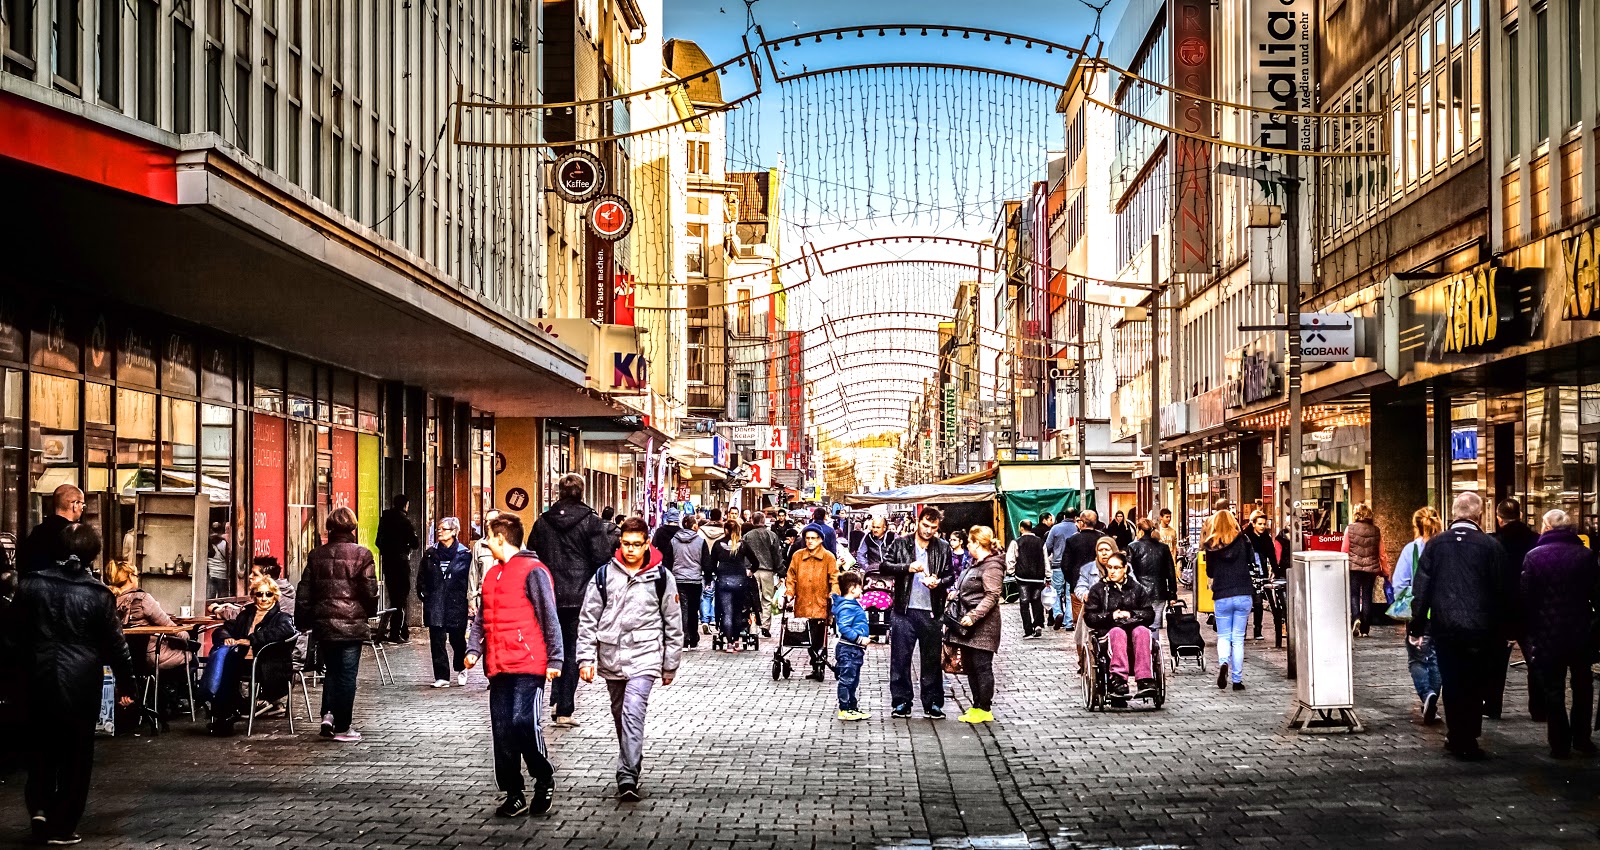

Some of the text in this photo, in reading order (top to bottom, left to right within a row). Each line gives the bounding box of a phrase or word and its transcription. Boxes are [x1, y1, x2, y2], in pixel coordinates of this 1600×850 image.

[1301, 12, 1310, 40] mehr
[1301, 44, 1309, 67] und
[1301, 69, 1310, 108] Medien
[566, 179, 590, 188] Kaffee
[596, 249, 604, 281] machen.
[596, 283, 604, 305] Pause
[1293, 467, 1300, 475] 19
[254, 508, 267, 529] BÜRO
